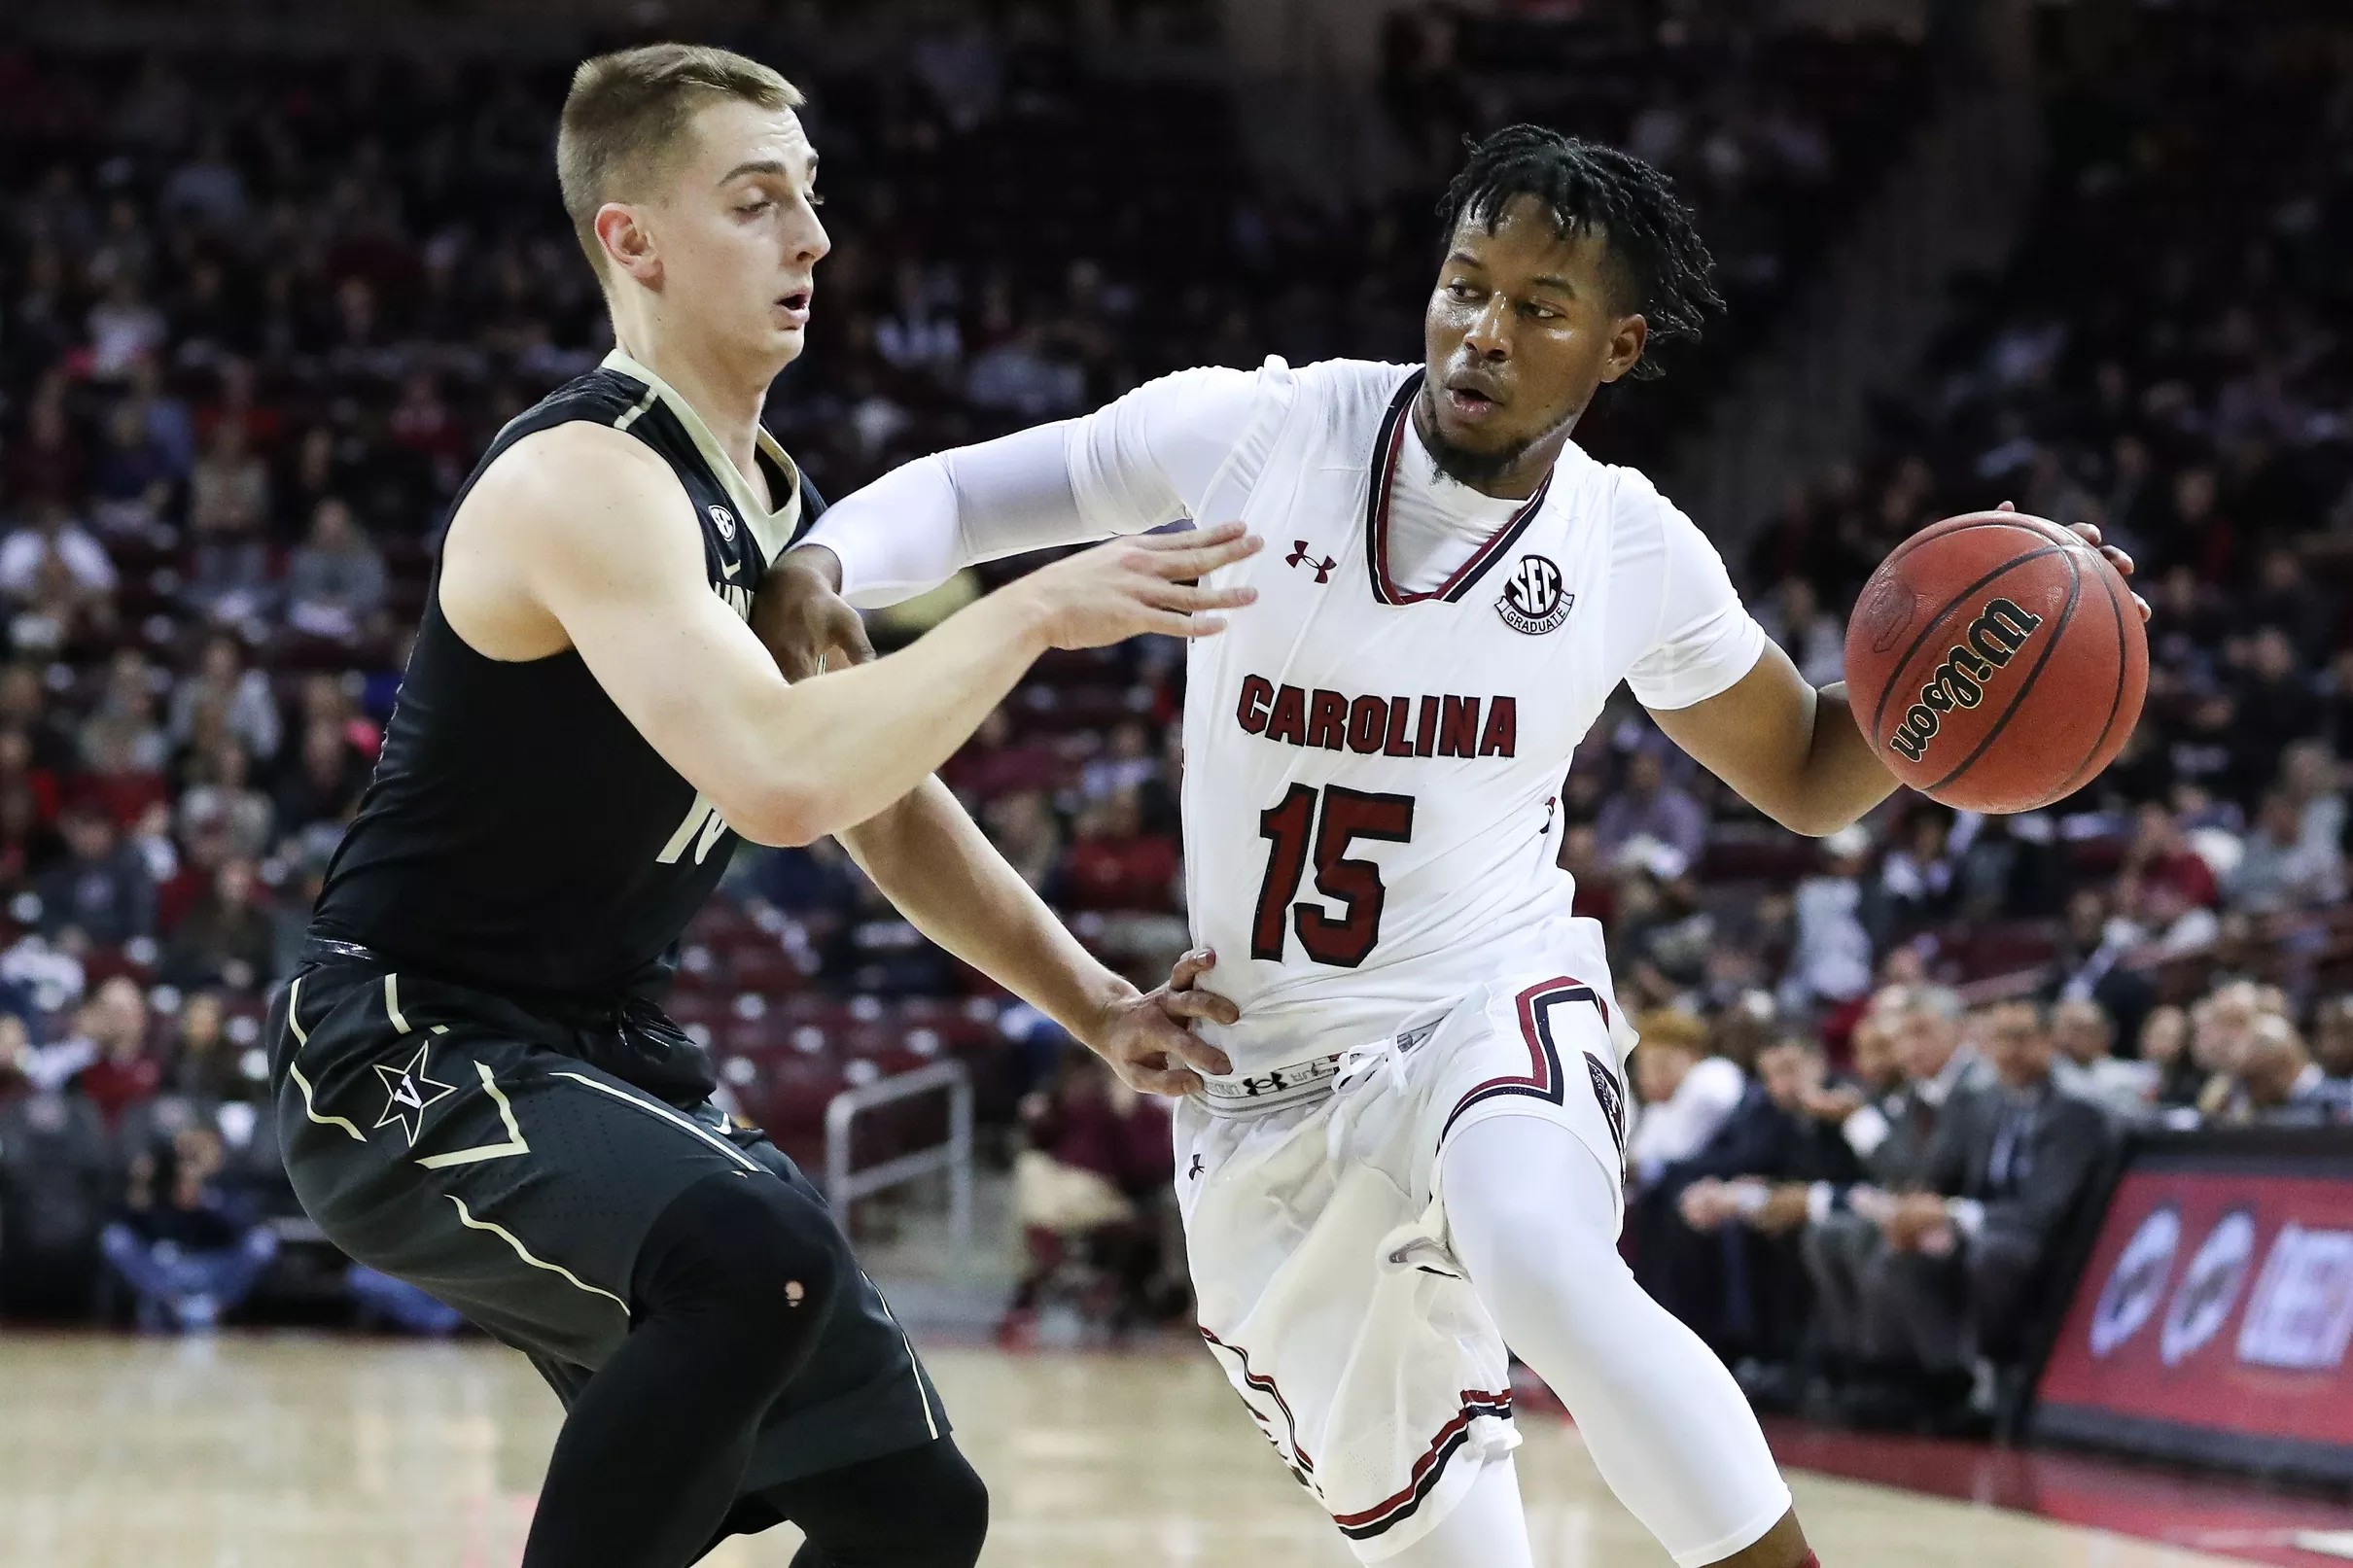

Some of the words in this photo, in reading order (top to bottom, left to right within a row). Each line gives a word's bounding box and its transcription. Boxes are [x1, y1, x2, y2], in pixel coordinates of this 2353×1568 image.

[1506, 607, 1566, 633] GRADUATE
[1510, 558, 1558, 614] SEC
[1889, 597, 2043, 763] Wilson
[1236, 673, 1517, 759] CAROLINA
[1250, 781, 1416, 969] 15
[393, 1073, 423, 1109] V
